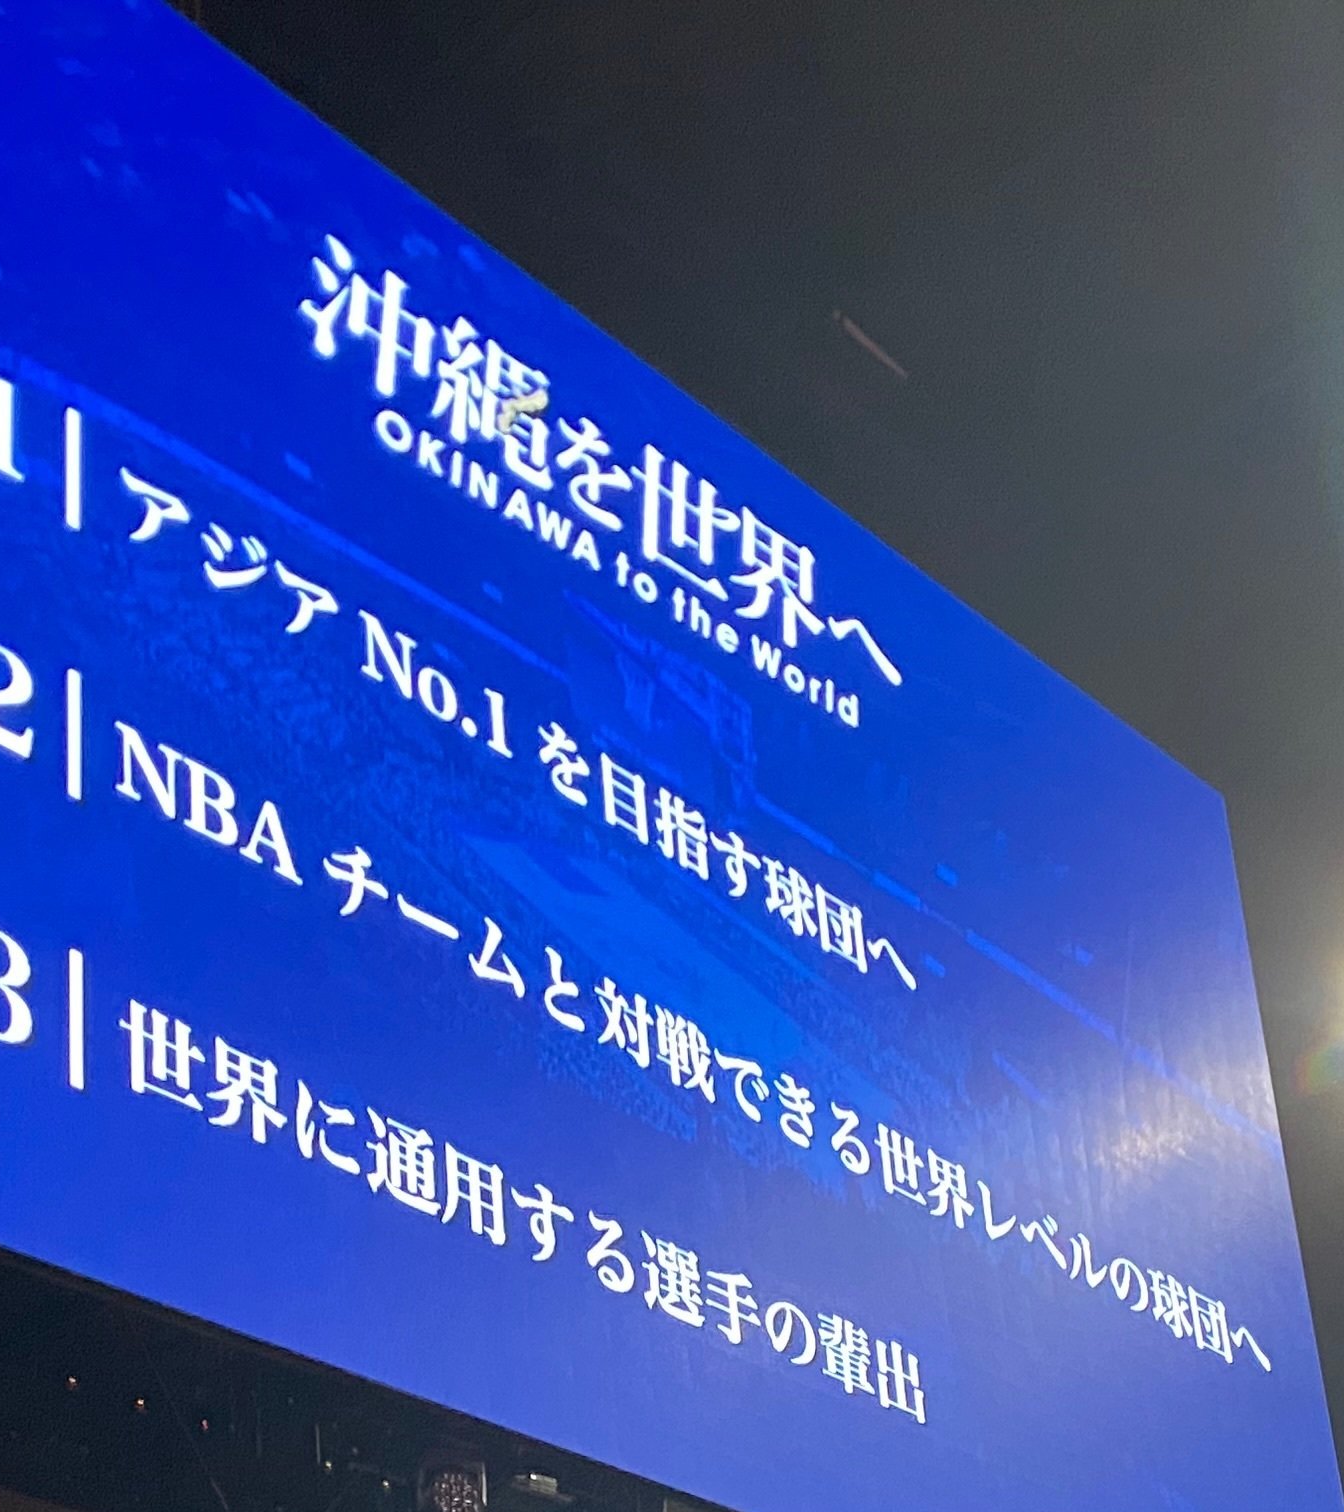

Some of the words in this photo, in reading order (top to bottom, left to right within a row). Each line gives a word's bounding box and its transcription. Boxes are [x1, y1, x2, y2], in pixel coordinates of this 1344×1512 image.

[300, 235, 902, 686] 沖縄を世界へ
[375, 410, 600, 571] OKINAWA
[616, 551, 658, 603] to
[672, 587, 739, 653] the
[751, 634, 859, 728] World
[121, 467, 339, 633] アジア
[359, 610, 512, 758] No.1
[539, 722, 917, 991] を目指す球団へ
[115, 721, 303, 885] NBA
[323, 846, 1272, 1372] チームと対戦できる世界レベルの球団へ
[119, 999, 926, 1424] 世界に通用する選手の輩出
